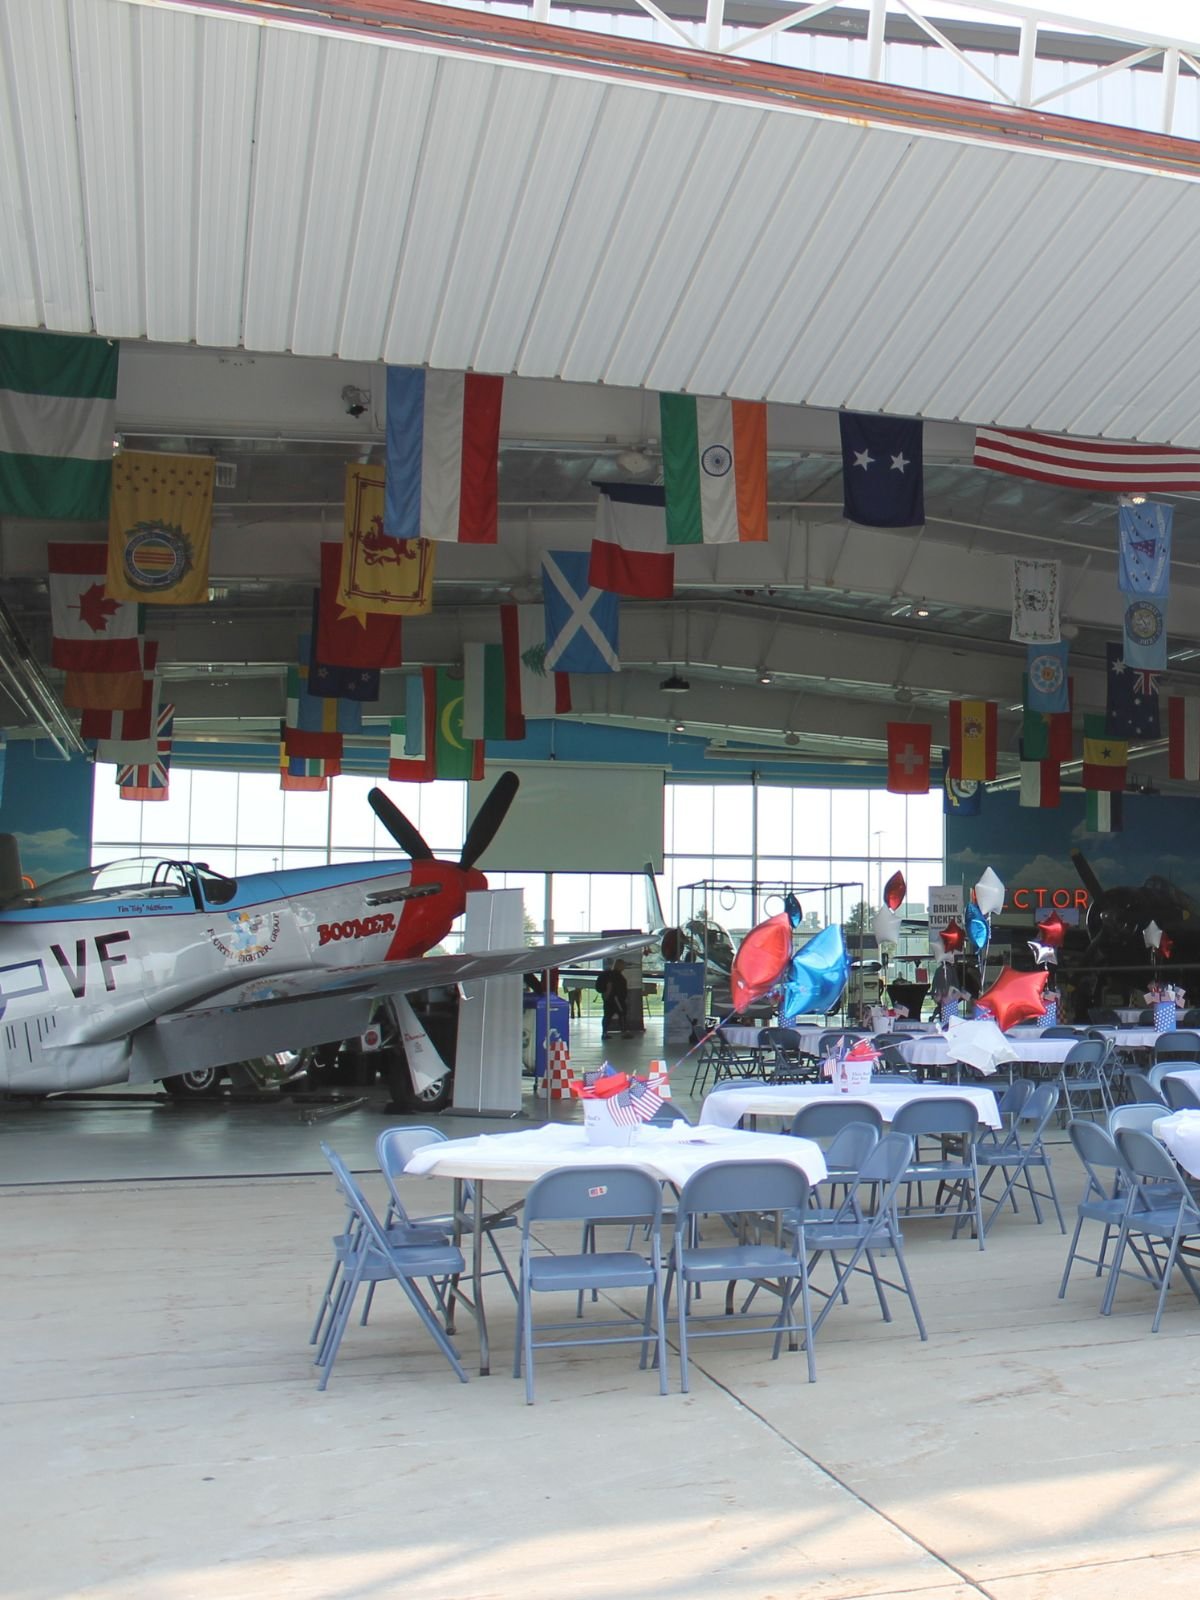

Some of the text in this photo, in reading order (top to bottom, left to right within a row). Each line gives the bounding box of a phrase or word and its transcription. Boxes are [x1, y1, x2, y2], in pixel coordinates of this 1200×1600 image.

[970, 889, 1089, 909] CTOR
[933, 904, 958, 914] DRINK
[930, 914, 962, 925] TICKETS
[317, 913, 396, 946] BOOMER
[238, 945, 273, 962] FIGHTER
[50, 930, 130, 998] VF
